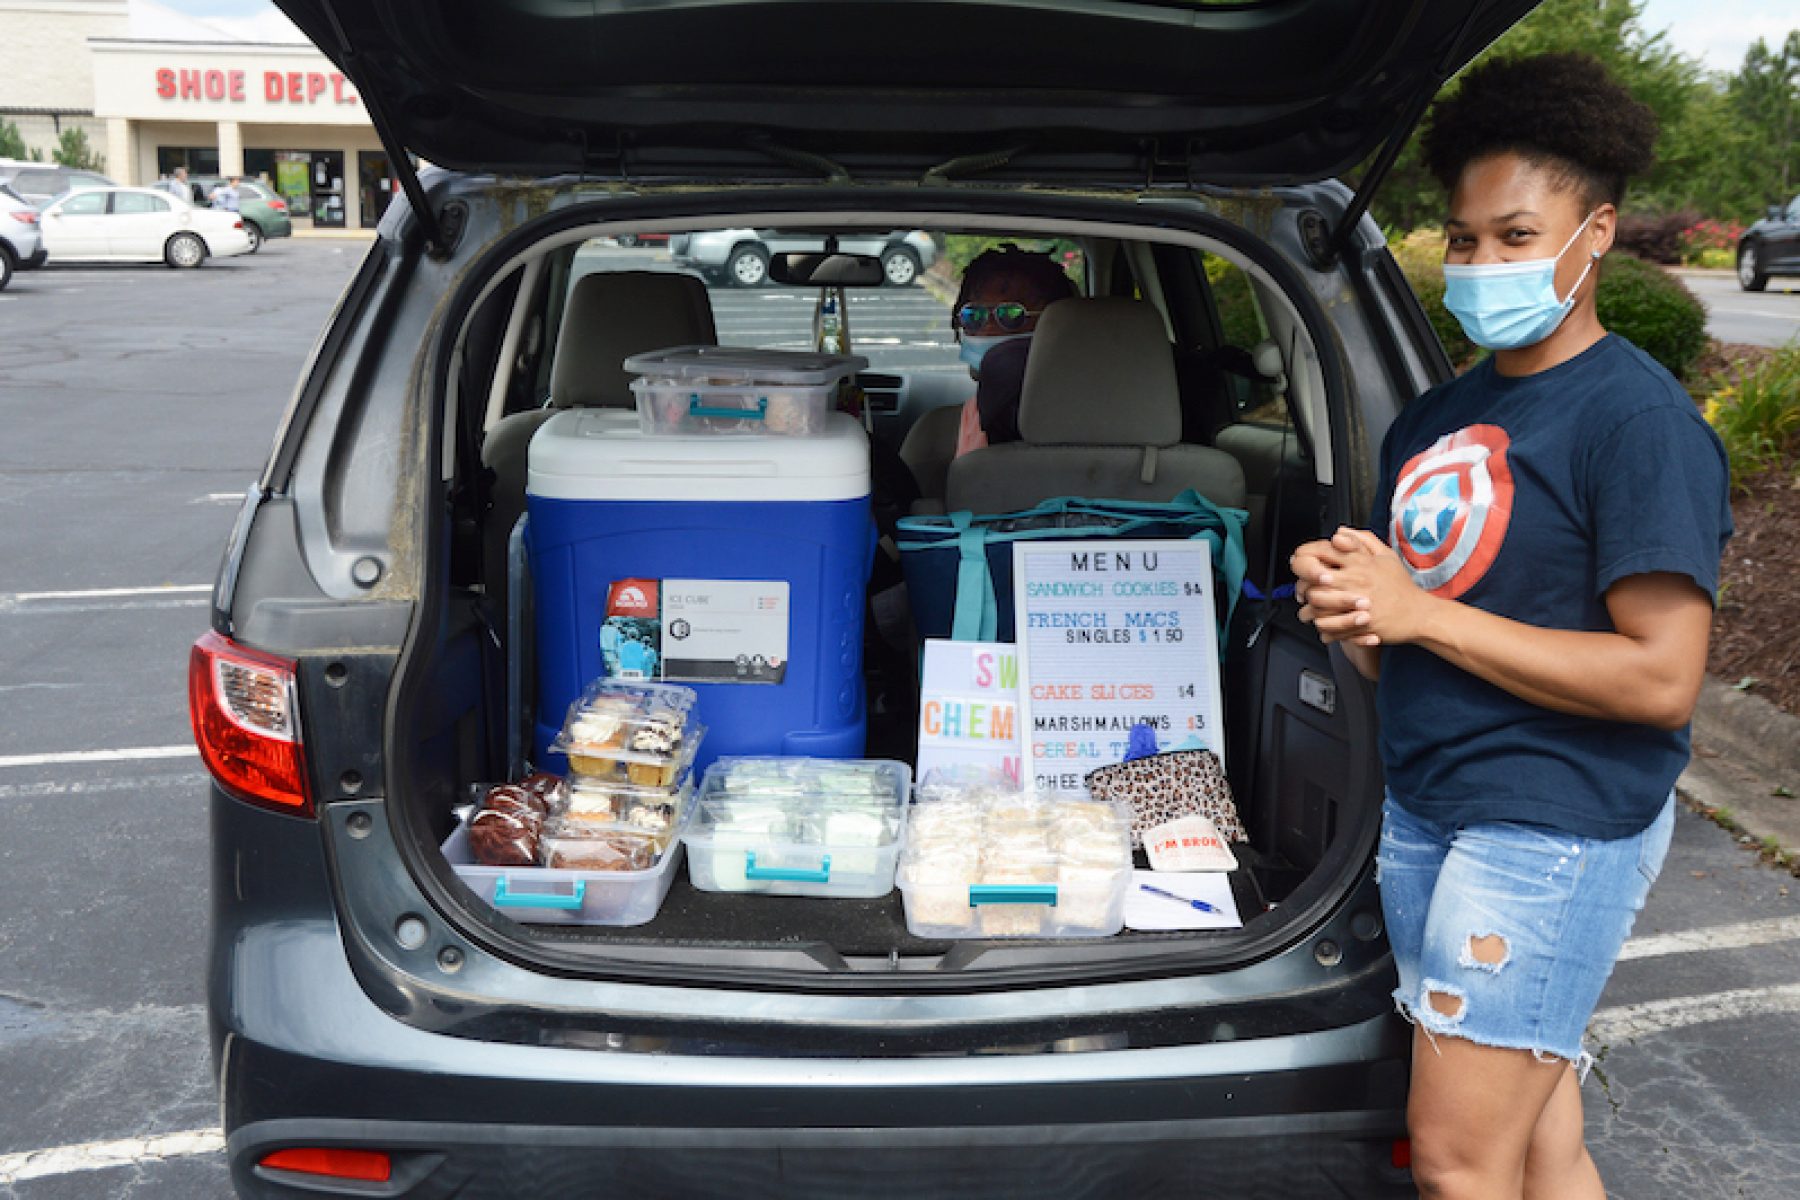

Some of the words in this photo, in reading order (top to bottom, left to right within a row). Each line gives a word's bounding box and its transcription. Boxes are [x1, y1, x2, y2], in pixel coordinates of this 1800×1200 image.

[156, 68, 246, 101] SHOE
[264, 71, 357, 104] DEPT.
[1071, 552, 1158, 571] MENU
[1026, 581, 1104, 597] SANDWICH
[1112, 581, 1178, 597] COOKIES
[1183, 581, 1203, 596] $4
[1027, 612, 1106, 628] FRENCH
[1125, 611, 1181, 627] MACS
[1066, 629, 1131, 644] SINGLES
[1030, 685, 1083, 700] CAKE
[1090, 685, 1156, 700] SLICES
[1177, 683, 1195, 698] $4
[1034, 715, 1171, 731] MARSHMALLOWS
[1186, 715, 1205, 731] $3
[1032, 741, 1101, 758] CEREAL
